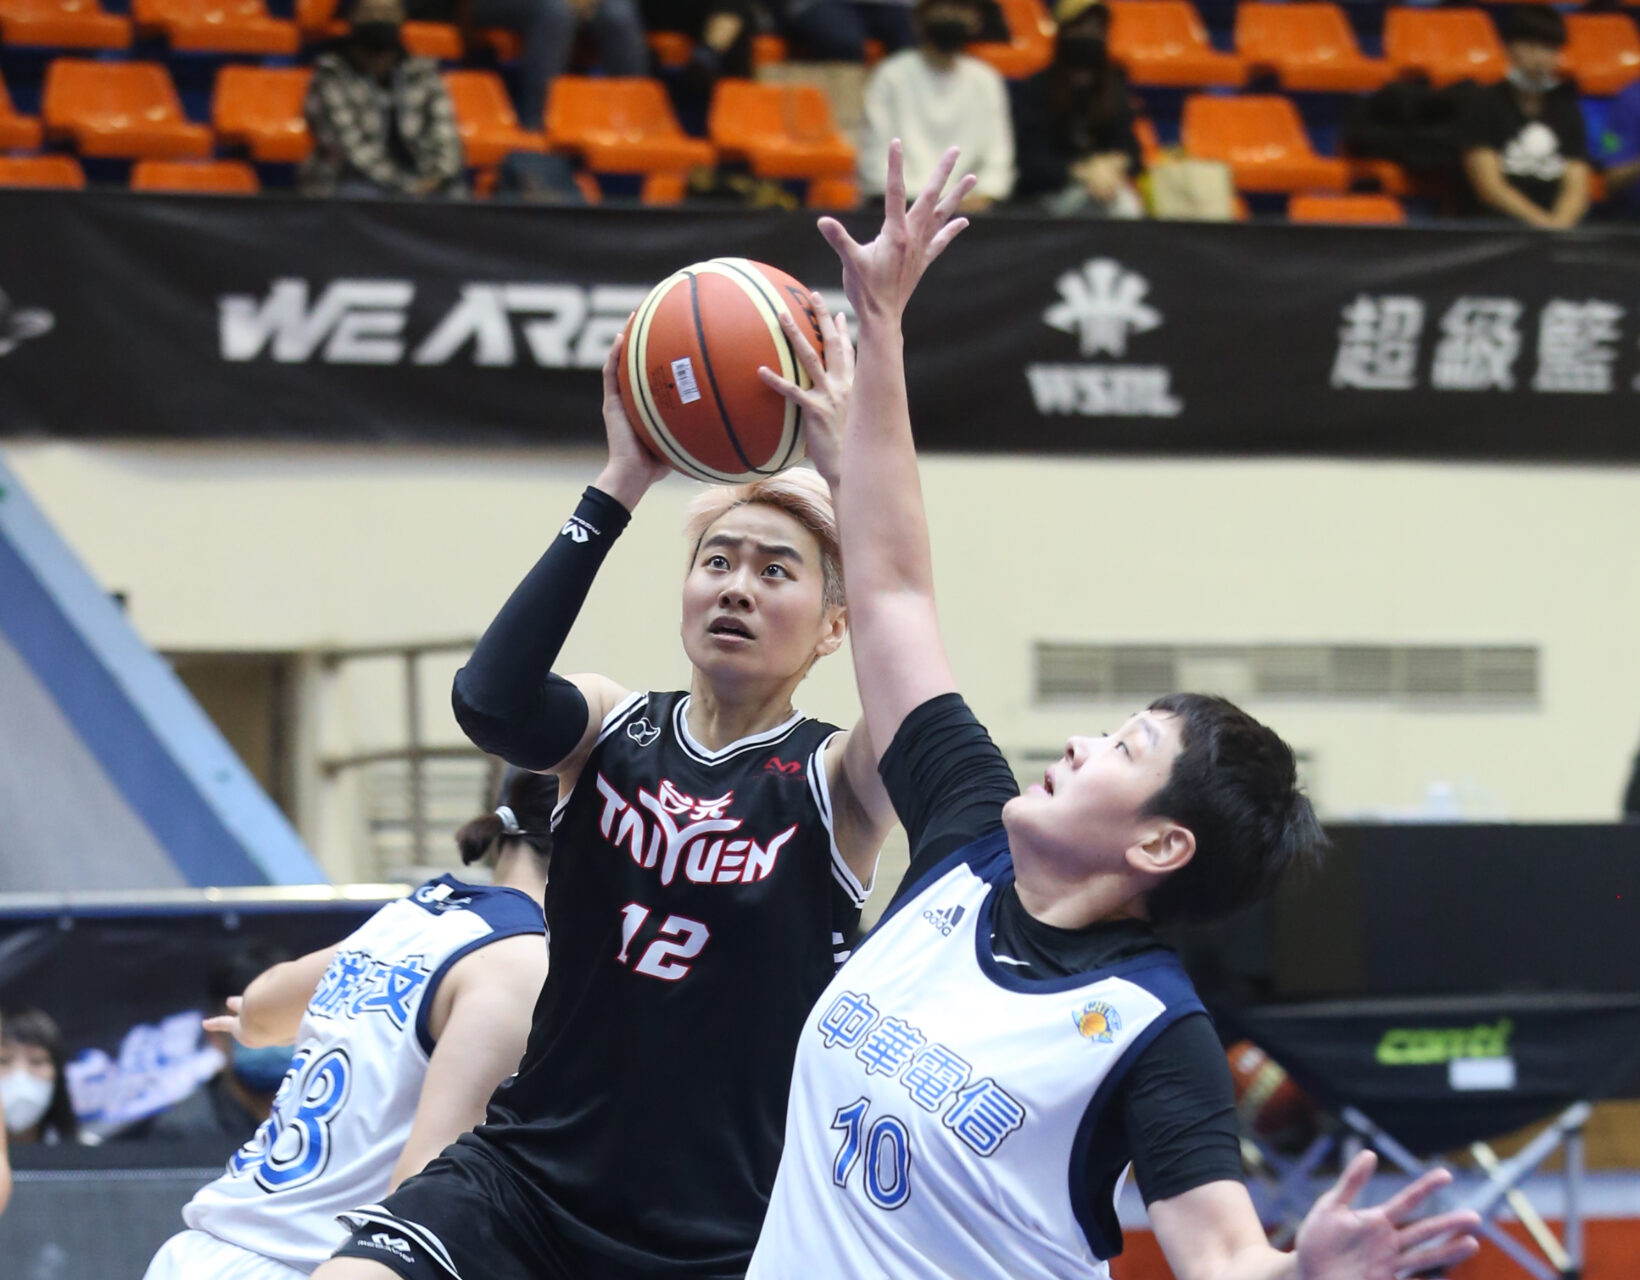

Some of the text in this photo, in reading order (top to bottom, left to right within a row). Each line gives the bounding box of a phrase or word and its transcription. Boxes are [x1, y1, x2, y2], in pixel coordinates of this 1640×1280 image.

[219, 277, 415, 364] WE
[1330, 294, 1640, 392] 超級籃
[596, 772, 799, 887] TAIYUEN
[615, 900, 711, 981] 12
[818, 990, 1026, 1158] 中華電信
[831, 1096, 911, 1211] 10
